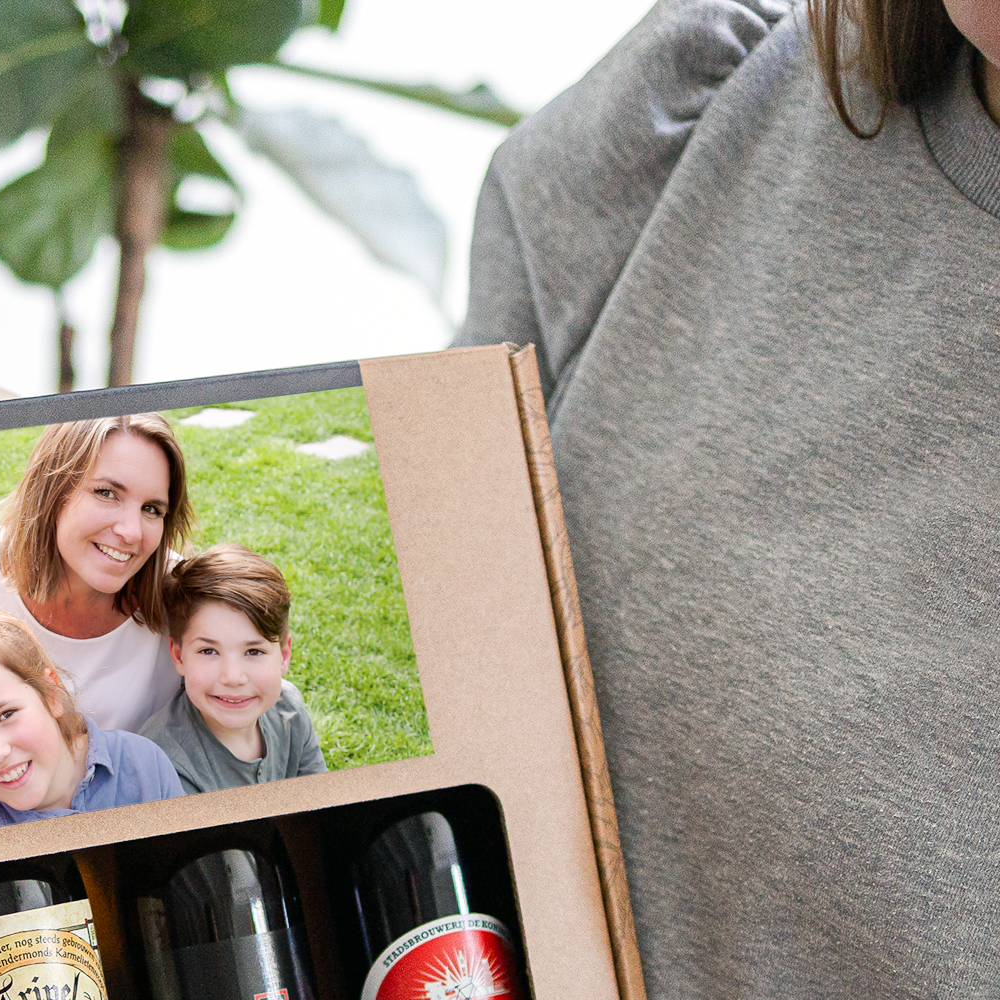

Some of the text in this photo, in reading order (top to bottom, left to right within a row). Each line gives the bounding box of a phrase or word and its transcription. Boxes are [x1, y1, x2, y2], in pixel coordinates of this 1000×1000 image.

[15, 938, 33, 948] nog
[35, 934, 60, 944] steeds
[382, 920, 466, 968] STADSBROUWERIJ
[468, 920, 480, 928] DE
